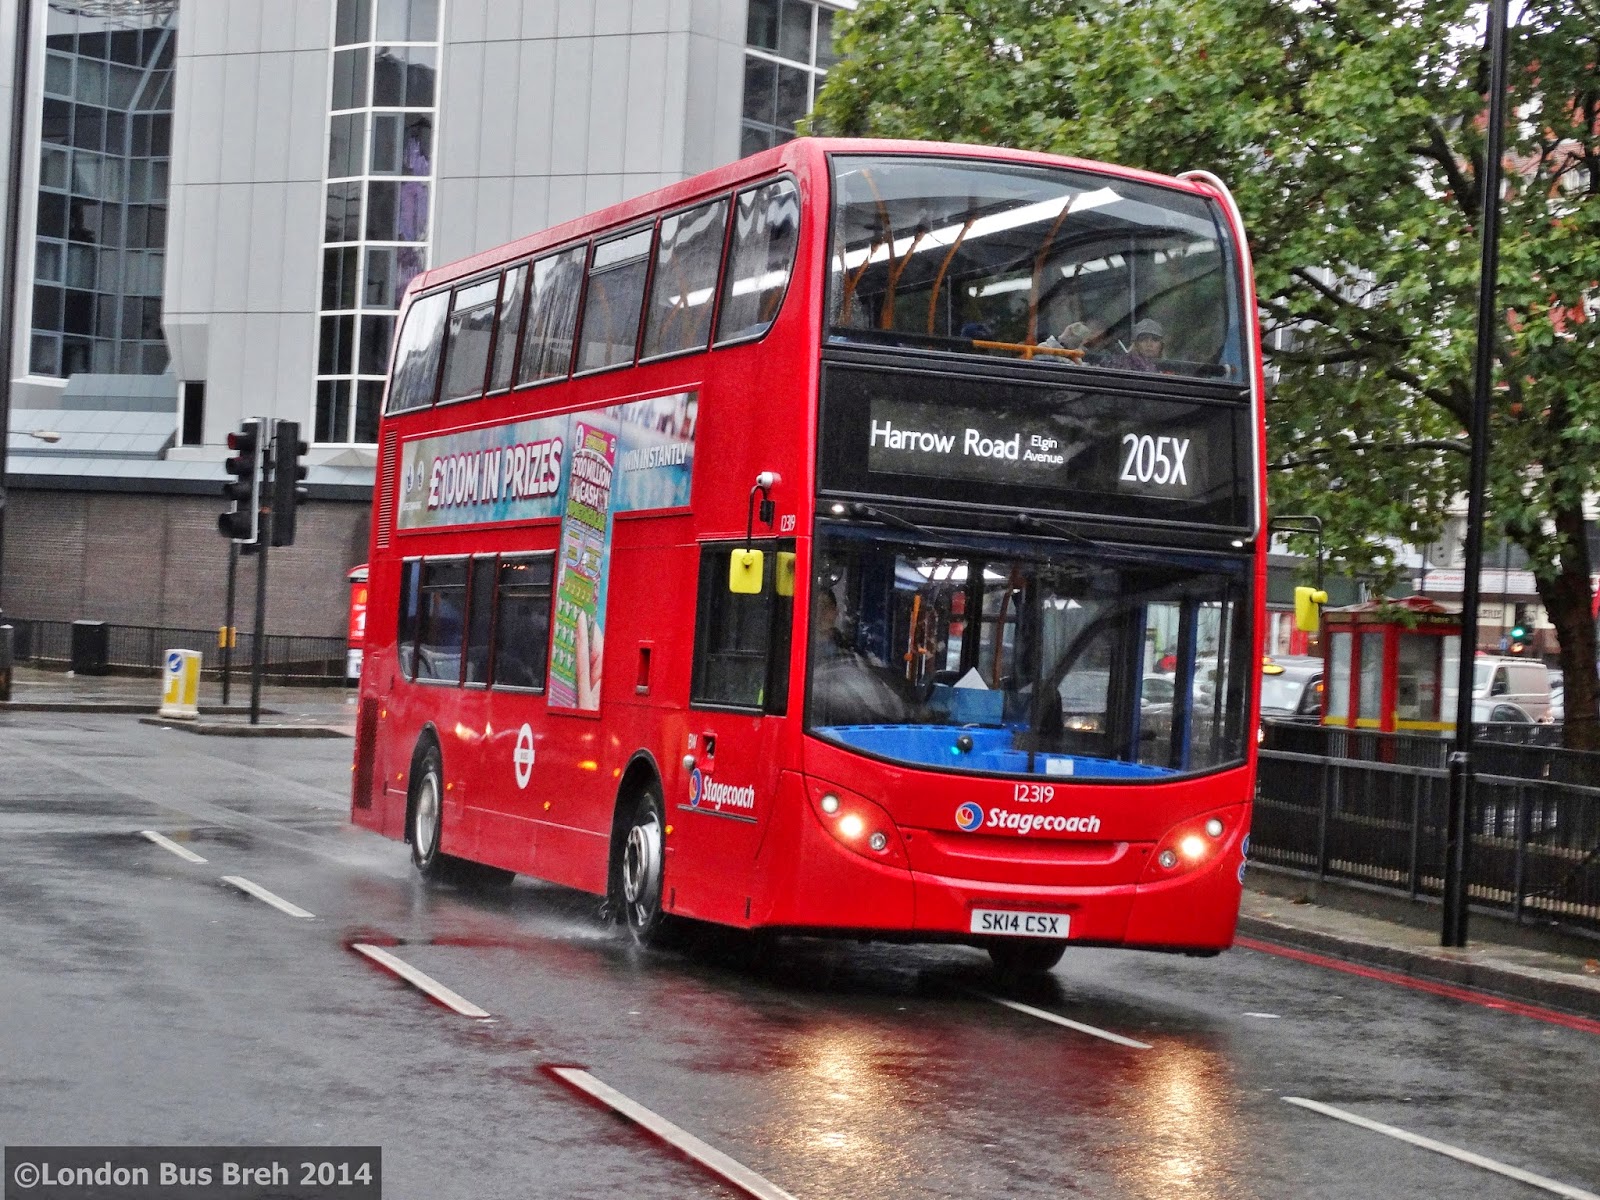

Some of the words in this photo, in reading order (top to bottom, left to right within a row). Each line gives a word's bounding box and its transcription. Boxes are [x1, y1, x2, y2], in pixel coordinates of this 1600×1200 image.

[870, 419, 956, 454] Harrow
[964, 428, 1020, 460] Road
[1030, 435, 1058, 450] Elgin
[640, 442, 688, 469] INSTANTLY
[1023, 449, 1064, 464] Avenue
[1119, 433, 1190, 486] 205X
[428, 453, 480, 510] £100M
[481, 449, 502, 502] IN
[502, 437, 564, 500] PRIZES
[580, 480, 599, 509] CASH
[702, 775, 755, 811] Stagecoach
[1014, 783, 1055, 804] 12319
[986, 807, 1101, 835] Stagecoach
[982, 912, 1020, 932] SK14
[1025, 915, 1060, 935] CSX
